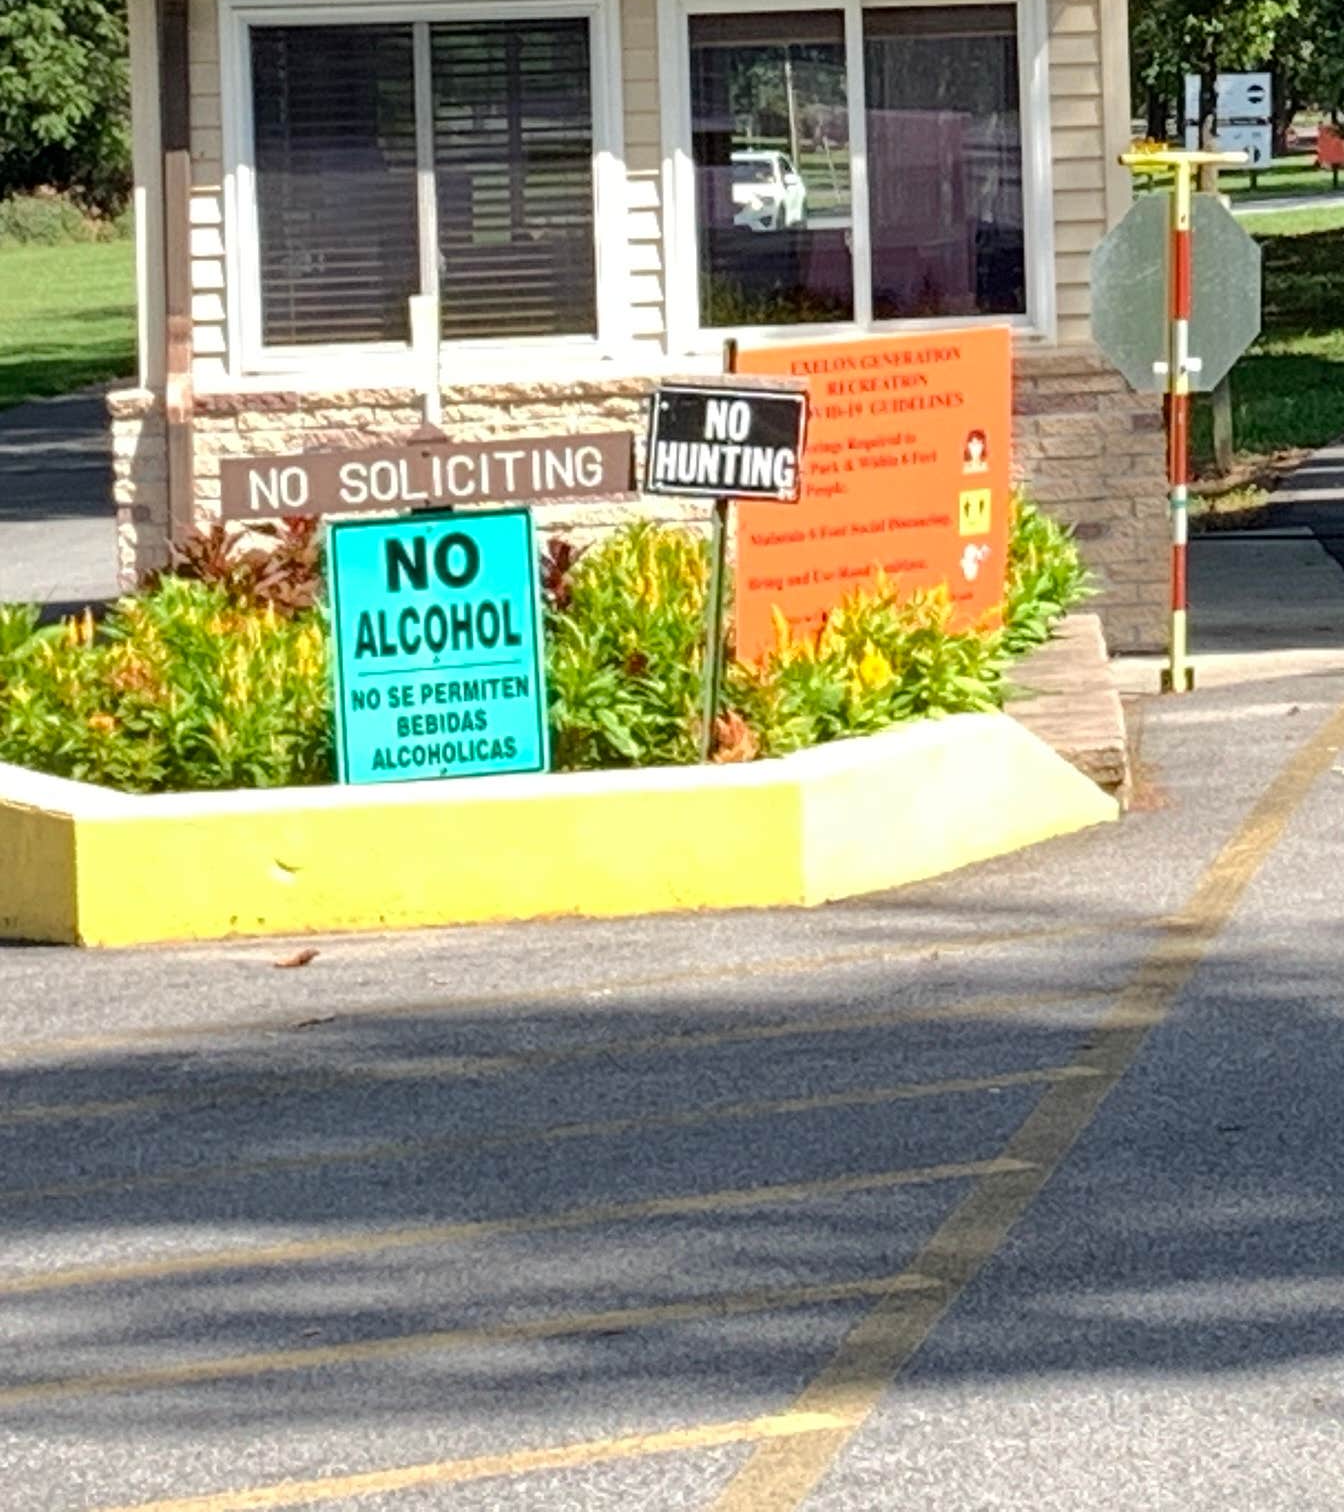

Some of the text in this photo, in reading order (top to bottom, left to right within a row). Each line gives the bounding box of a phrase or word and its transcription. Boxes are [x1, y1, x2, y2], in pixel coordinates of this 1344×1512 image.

[790, 346, 961, 376] EXELON GENERATION
[826, 373, 929, 396] RECREATION
[704, 399, 752, 442] NO
[809, 391, 965, 420] VID-19 GUIDELINES
[248, 445, 603, 512] NO SOLICITING
[655, 441, 795, 488] HUNTING
[385, 532, 481, 593] NO
[354, 604, 523, 659] ALCOHOL
[351, 676, 530, 712] NO SE PERMITEN
[397, 710, 488, 738] BEBIDAS
[371, 738, 518, 772] ALCOHOLICAS
